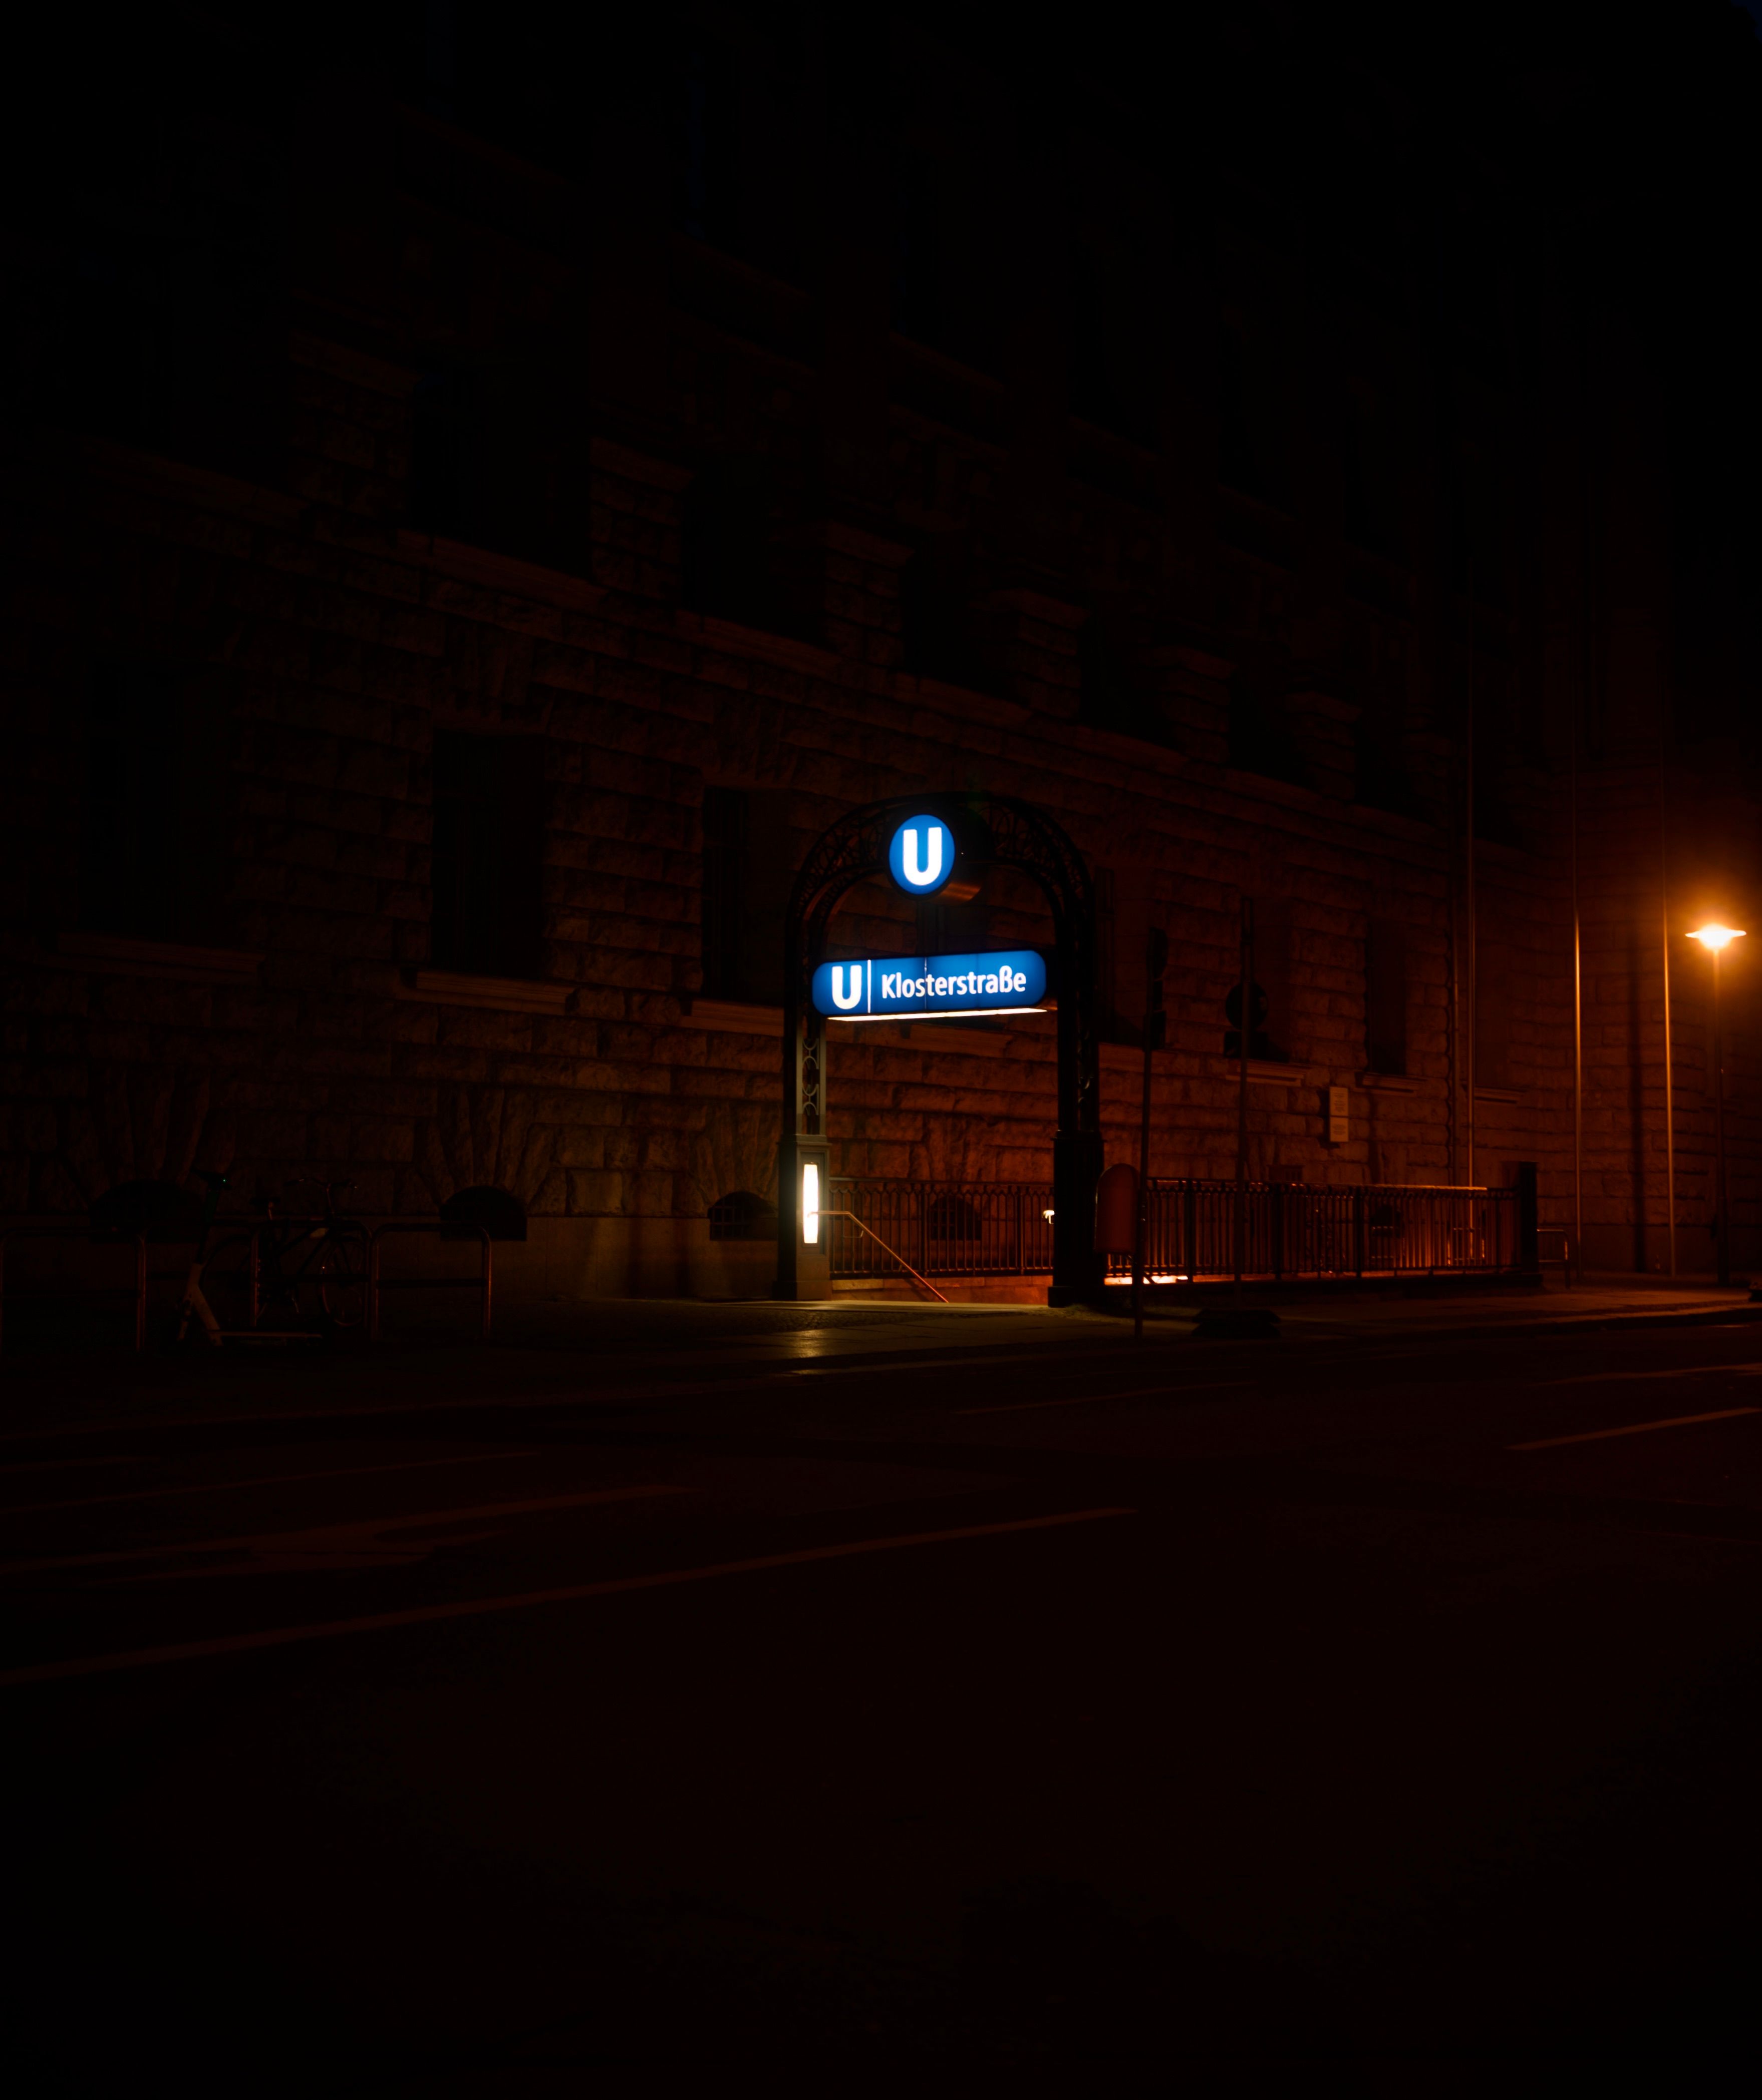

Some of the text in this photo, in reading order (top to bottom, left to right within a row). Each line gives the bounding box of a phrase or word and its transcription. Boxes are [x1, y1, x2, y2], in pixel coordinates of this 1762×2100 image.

[903, 827, 942, 886] U
[831, 964, 1026, 1009] U Klosterstraße
